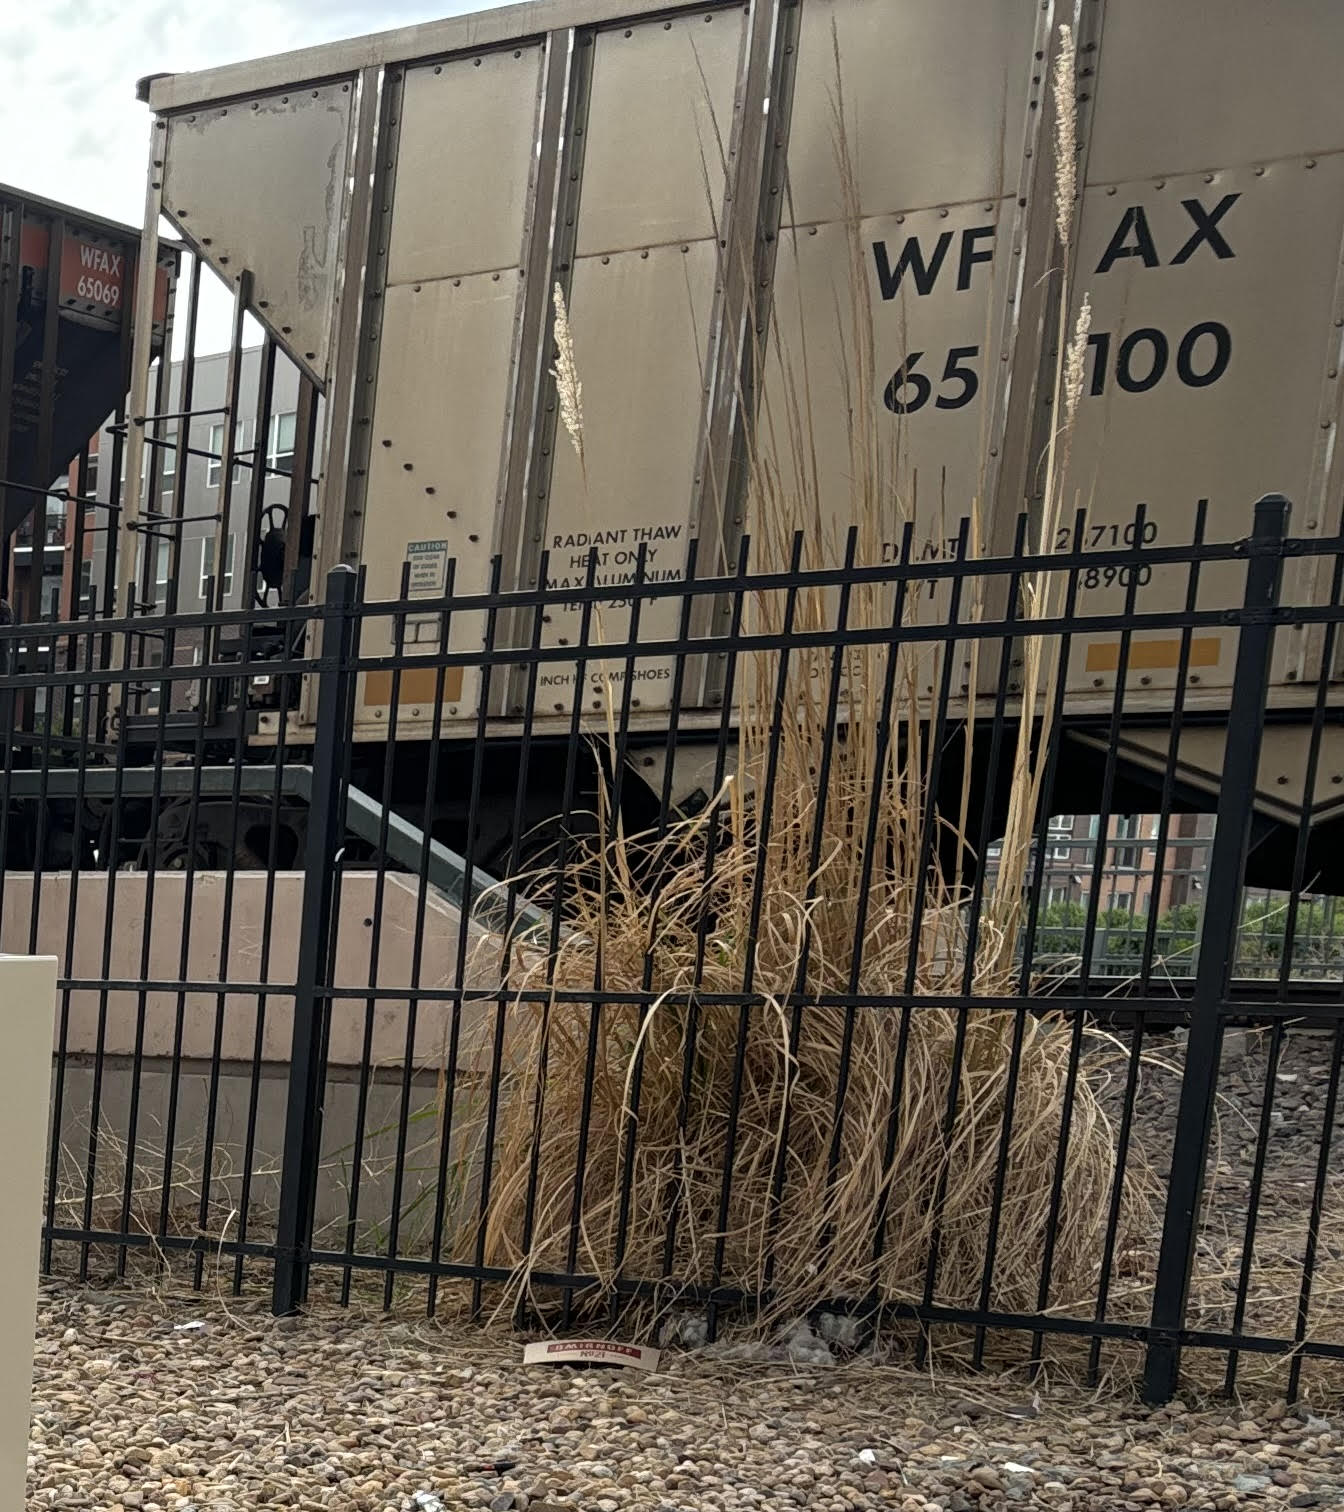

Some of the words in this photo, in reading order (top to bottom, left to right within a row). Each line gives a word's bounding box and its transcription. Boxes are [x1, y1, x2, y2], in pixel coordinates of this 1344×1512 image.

[1094, 193, 1242, 274] AX
[80, 244, 121, 277] WFAX
[77, 276, 120, 306] 65069
[883, 345, 980, 415] 65
[1087, 321, 1233, 397] 100
[408, 542, 447, 552] CAUTION
[553, 529, 628, 548] RADIANT
[633, 525, 682, 542] THAW
[1055, 522, 1157, 549] 27100
[614, 549, 657, 565] ONY
[596, 569, 681, 586] LUMNUM
[1078, 564, 1151, 590] 8900
[541, 674, 570, 686] INCH
